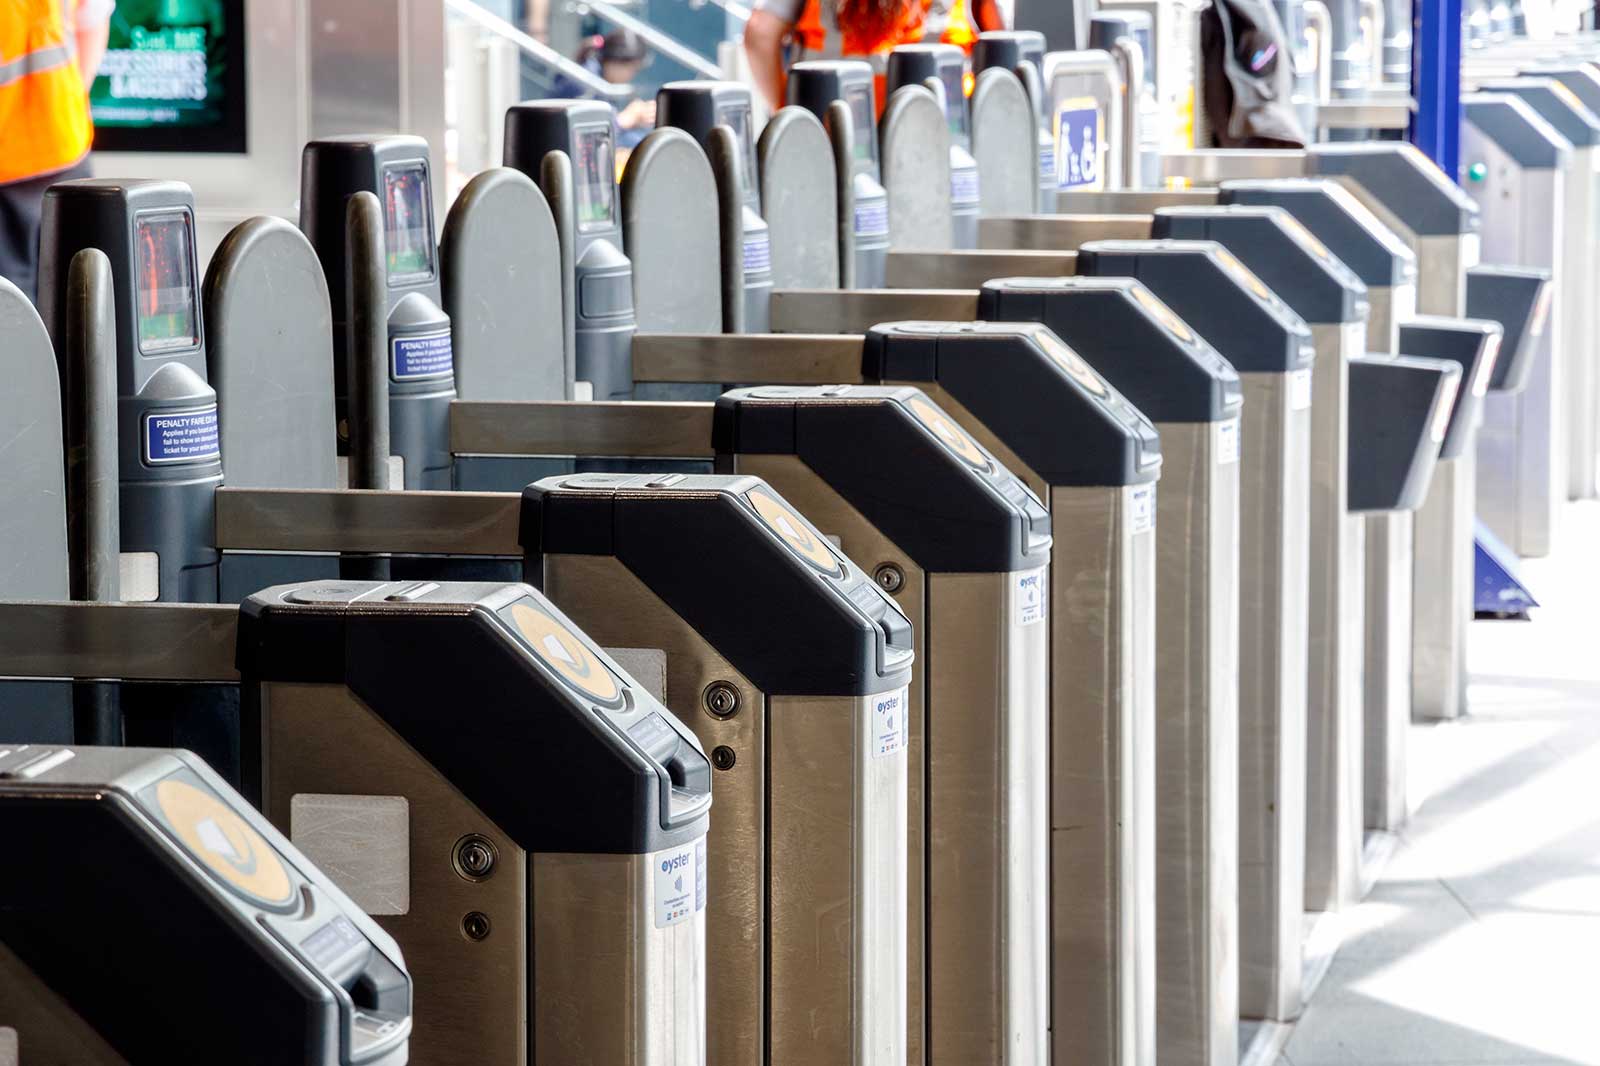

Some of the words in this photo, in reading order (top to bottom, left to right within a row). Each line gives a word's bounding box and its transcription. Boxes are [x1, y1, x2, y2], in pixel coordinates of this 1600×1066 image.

[156, 419, 190, 428] PENALTY
[877, 697, 899, 715] oyster
[661, 852, 690, 874] oyster
